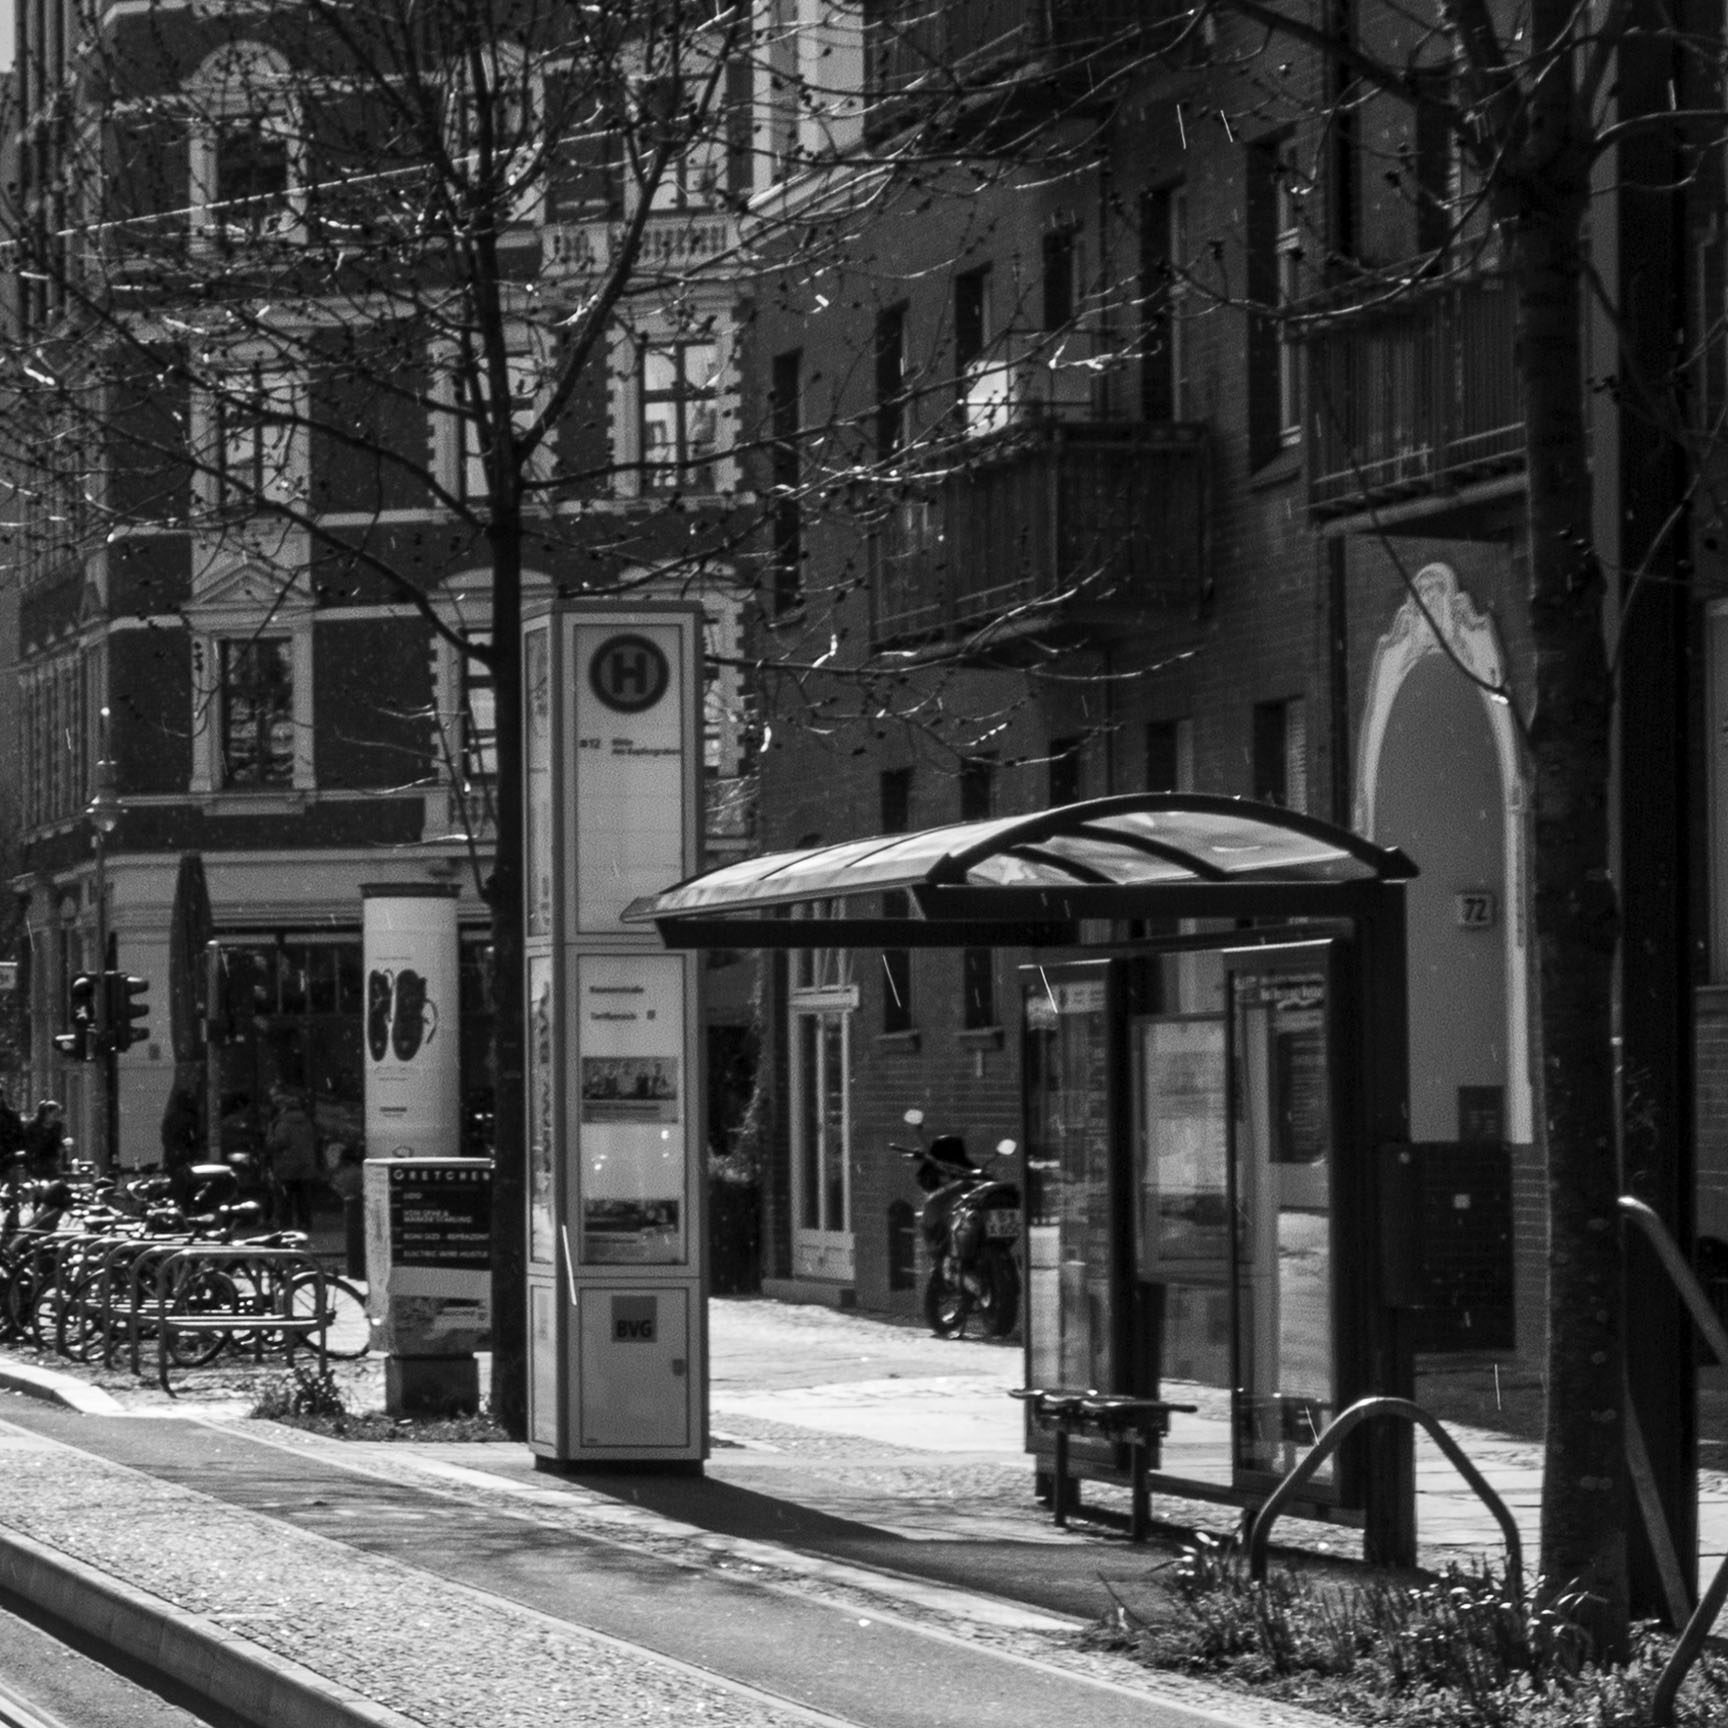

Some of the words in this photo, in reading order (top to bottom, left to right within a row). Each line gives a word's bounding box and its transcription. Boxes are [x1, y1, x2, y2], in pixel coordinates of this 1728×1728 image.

[613, 652, 647, 694] H
[1464, 897, 1487, 921] 72
[393, 1169, 491, 1181] GRETCHEN
[617, 1319, 652, 1338] BVG
